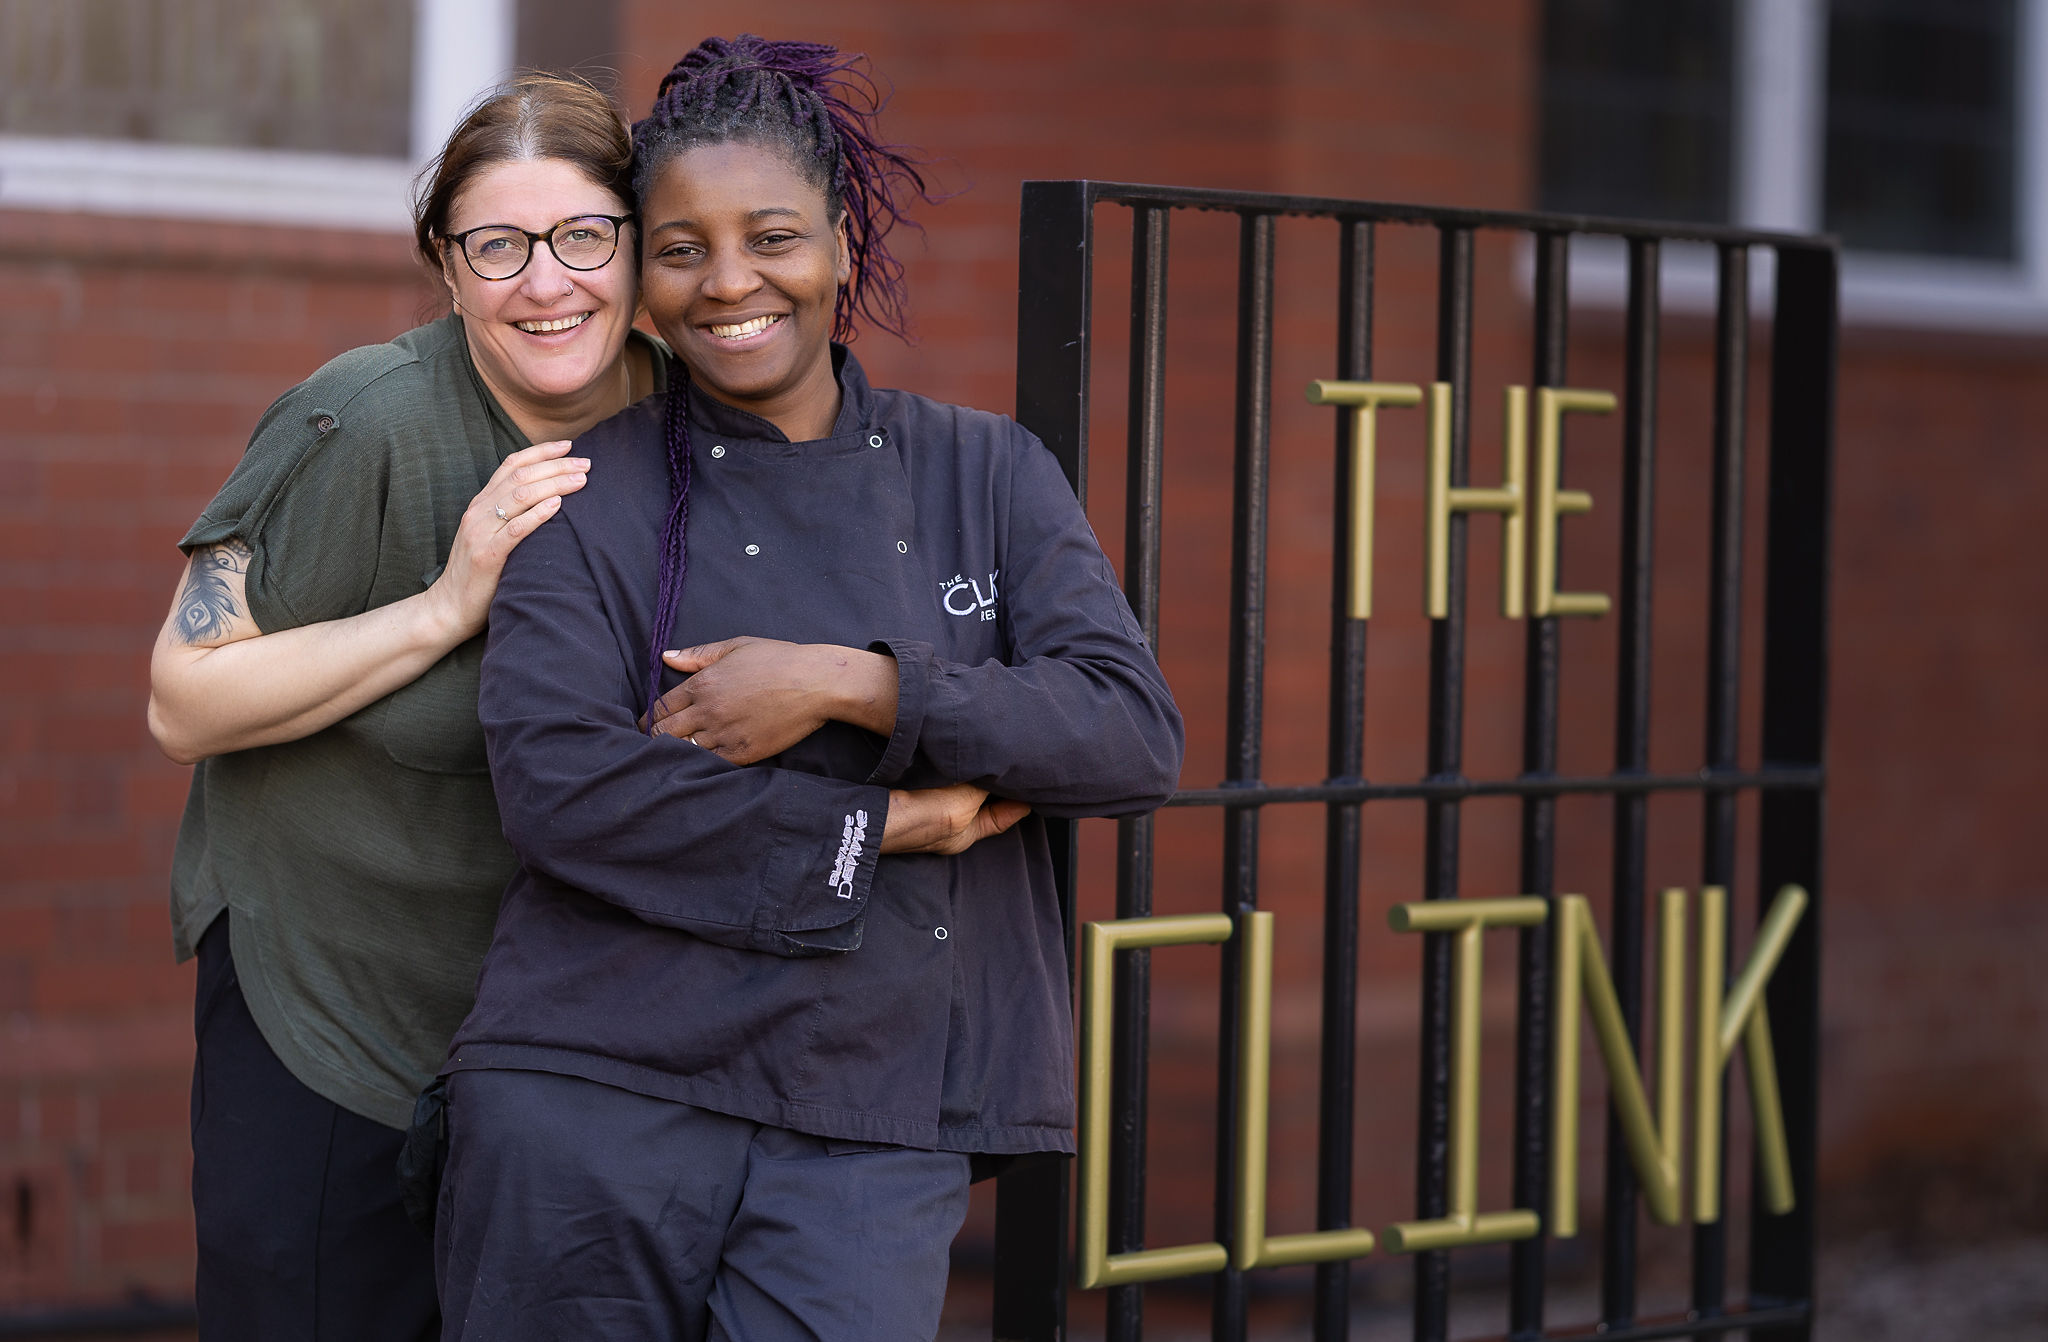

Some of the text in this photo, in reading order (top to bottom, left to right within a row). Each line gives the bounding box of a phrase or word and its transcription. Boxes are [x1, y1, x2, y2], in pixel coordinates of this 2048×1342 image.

[939, 574, 963, 590] THE
[1305, 379, 1618, 619] THE
[1078, 883, 1809, 1289] CLINK
